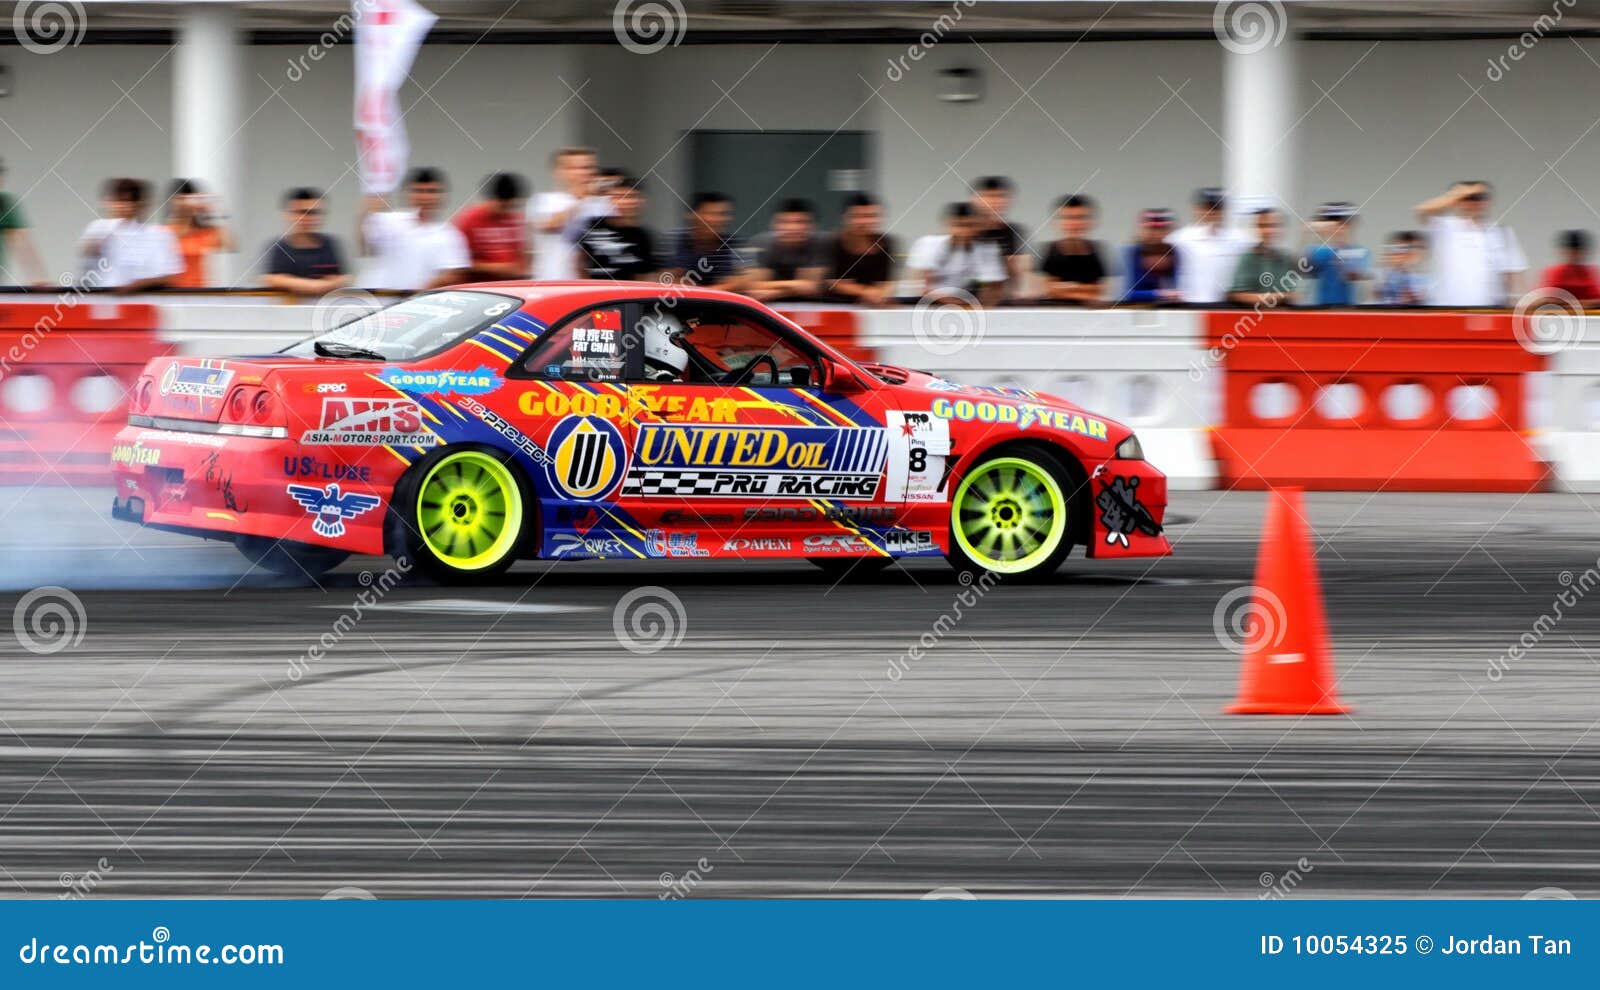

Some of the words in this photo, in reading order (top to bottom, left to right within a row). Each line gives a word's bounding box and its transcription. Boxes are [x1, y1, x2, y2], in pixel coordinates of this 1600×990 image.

[573, 341, 589, 352] FAT
[591, 342, 616, 353] CHAN
[321, 400, 421, 433] AMS
[903, 413, 929, 424] PRO
[303, 433, 435, 444] ASIA-MOTORSPORT.COM
[640, 427, 788, 468] UNITED
[787, 442, 829, 469] OIL
[283, 455, 314, 476] US
[321, 462, 372, 482] LUBE
[909, 447, 928, 472] 8
[712, 474, 768, 493] PRO
[777, 476, 878, 496] RACING
[886, 531, 932, 545] HKS
